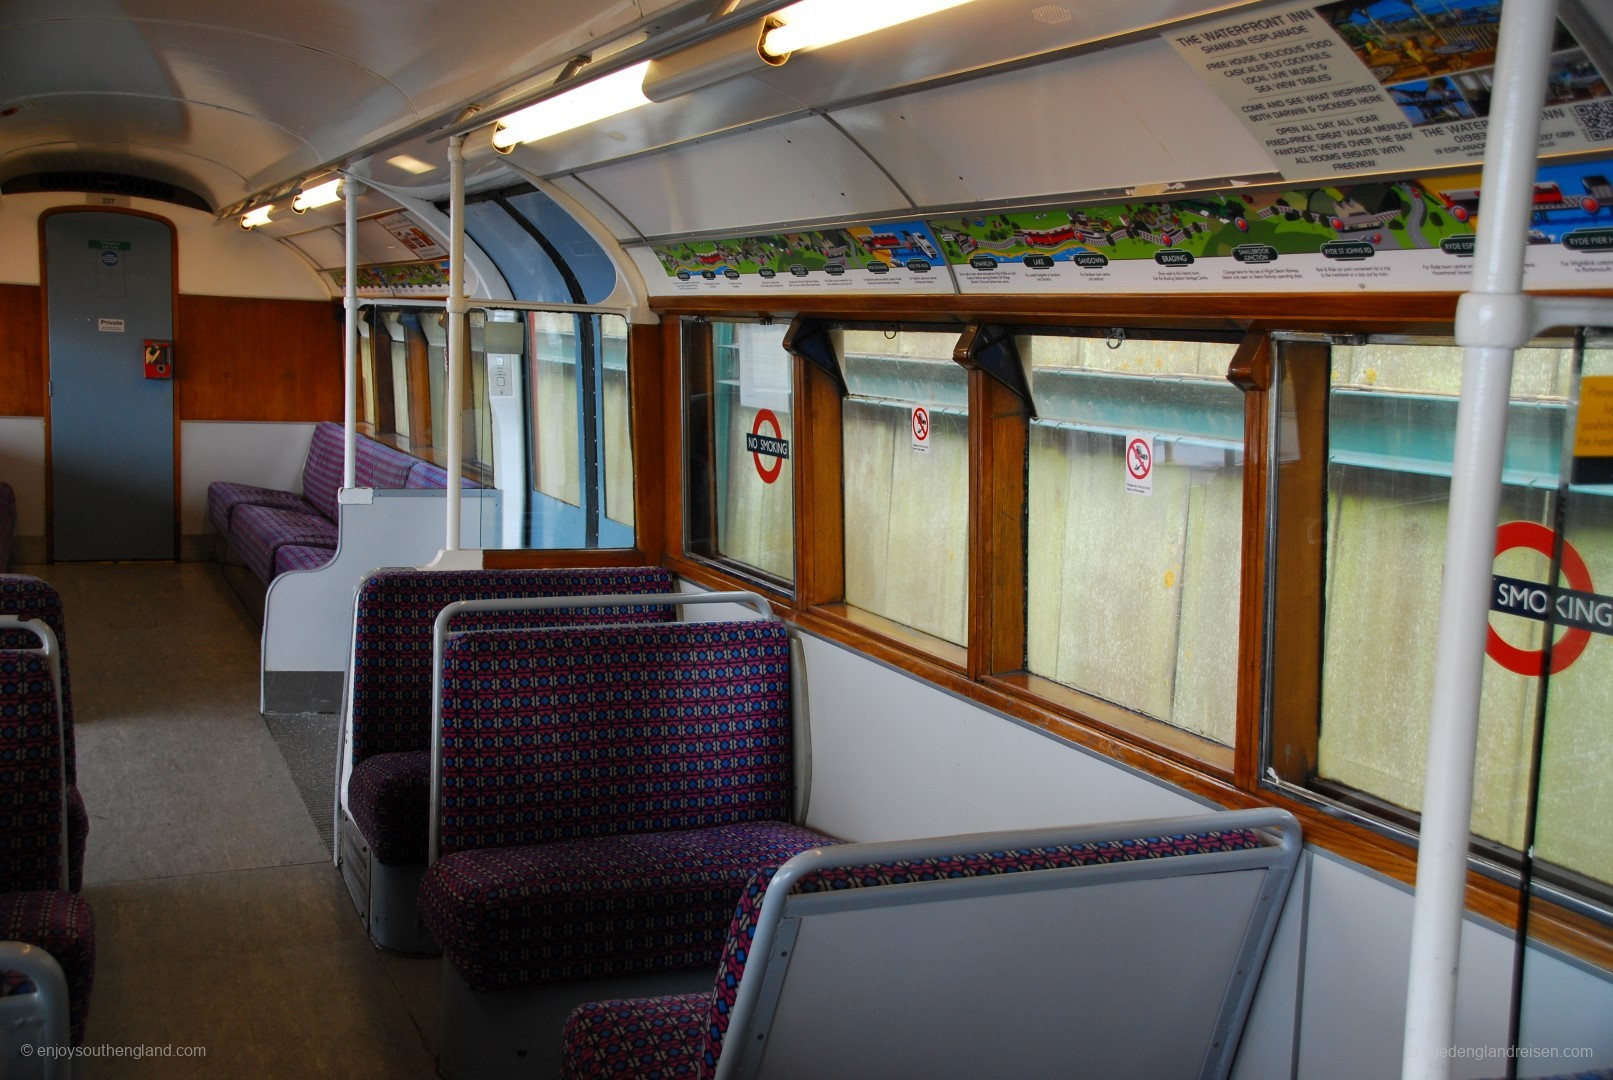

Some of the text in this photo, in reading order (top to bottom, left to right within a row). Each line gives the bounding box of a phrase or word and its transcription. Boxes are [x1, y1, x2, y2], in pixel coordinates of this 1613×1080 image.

[1175, 9, 1315, 47] THE WATERFRONT INN
[1200, 25, 1308, 54] SHANKLIN ESPLANADE
[1206, 60, 1228, 71] FREE
[1258, 44, 1305, 60] DELICIOUS
[1224, 66, 1247, 78] CASK
[1248, 62, 1268, 74] ALES
[1268, 61, 1282, 69] TO
[1242, 76, 1269, 85] LOCAL
[1268, 71, 1288, 80] LIVE
[1288, 66, 1318, 76] MUSIC
[1254, 74, 1332, 94] SEA VIEW TABLES
[1241, 84, 1376, 113] COME AND SEE WHAT INSPIRED
[1249, 114, 1272, 123] BOTH
[1272, 107, 1308, 120] DARWIN
[1318, 99, 1357, 112] DICKENS
[1356, 94, 1384, 106] HERE
[1276, 126, 1300, 136] OPEN
[1301, 124, 1317, 132] ALL
[1337, 119, 1353, 127] ALL
[1354, 114, 1379, 124] YEAR
[1315, 130, 1342, 142] GREAT
[1342, 126, 1372, 137] VALUE
[1373, 122, 1408, 133] MENUS
[1420, 126, 1445, 138] THE
[1445, 120, 1488, 134] WATER
[1274, 132, 1414, 156] FANTASTIC VIEWS OVER THE BAY
[1294, 144, 1405, 165] ALL ROOMS ENSUITE WITH
[1332, 160, 1376, 172] FREEVIEW
[1569, 238, 1589, 246] RYDE
[1590, 236, 1607, 244] PIER
[1032, 258, 1045, 266] LAKE
[1078, 256, 1105, 265] SANDOWN
[1162, 254, 1188, 263] BRADING
[748, 437, 788, 456] NO SMOKING
[1498, 583, 1613, 627] SMOKING
